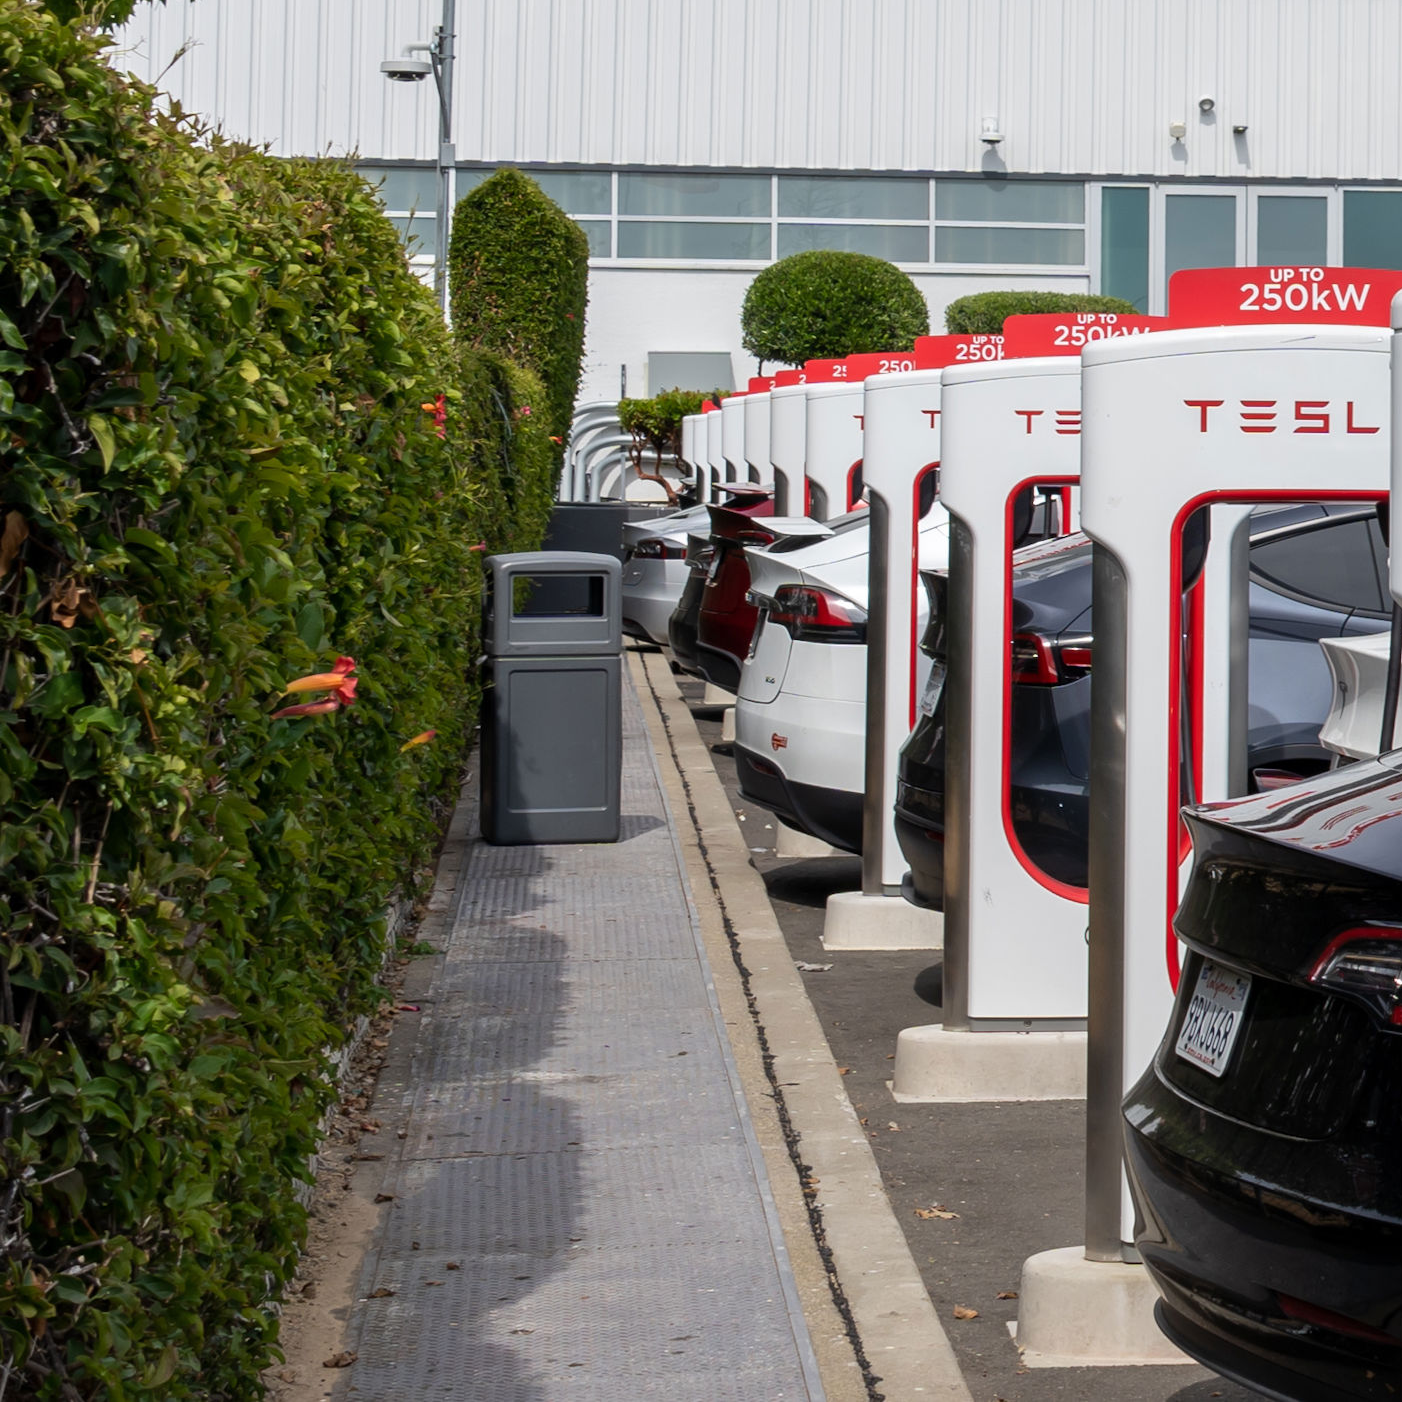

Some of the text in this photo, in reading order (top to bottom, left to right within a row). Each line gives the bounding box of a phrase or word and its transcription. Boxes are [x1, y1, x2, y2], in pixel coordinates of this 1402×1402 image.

[1269, 267, 1325, 283] UP TO
[1239, 282, 1371, 311] 250kW
[1077, 313, 1117, 325] UP TO
[972, 335, 1005, 344] UP TO
[1183, 399, 1380, 434] TESL
